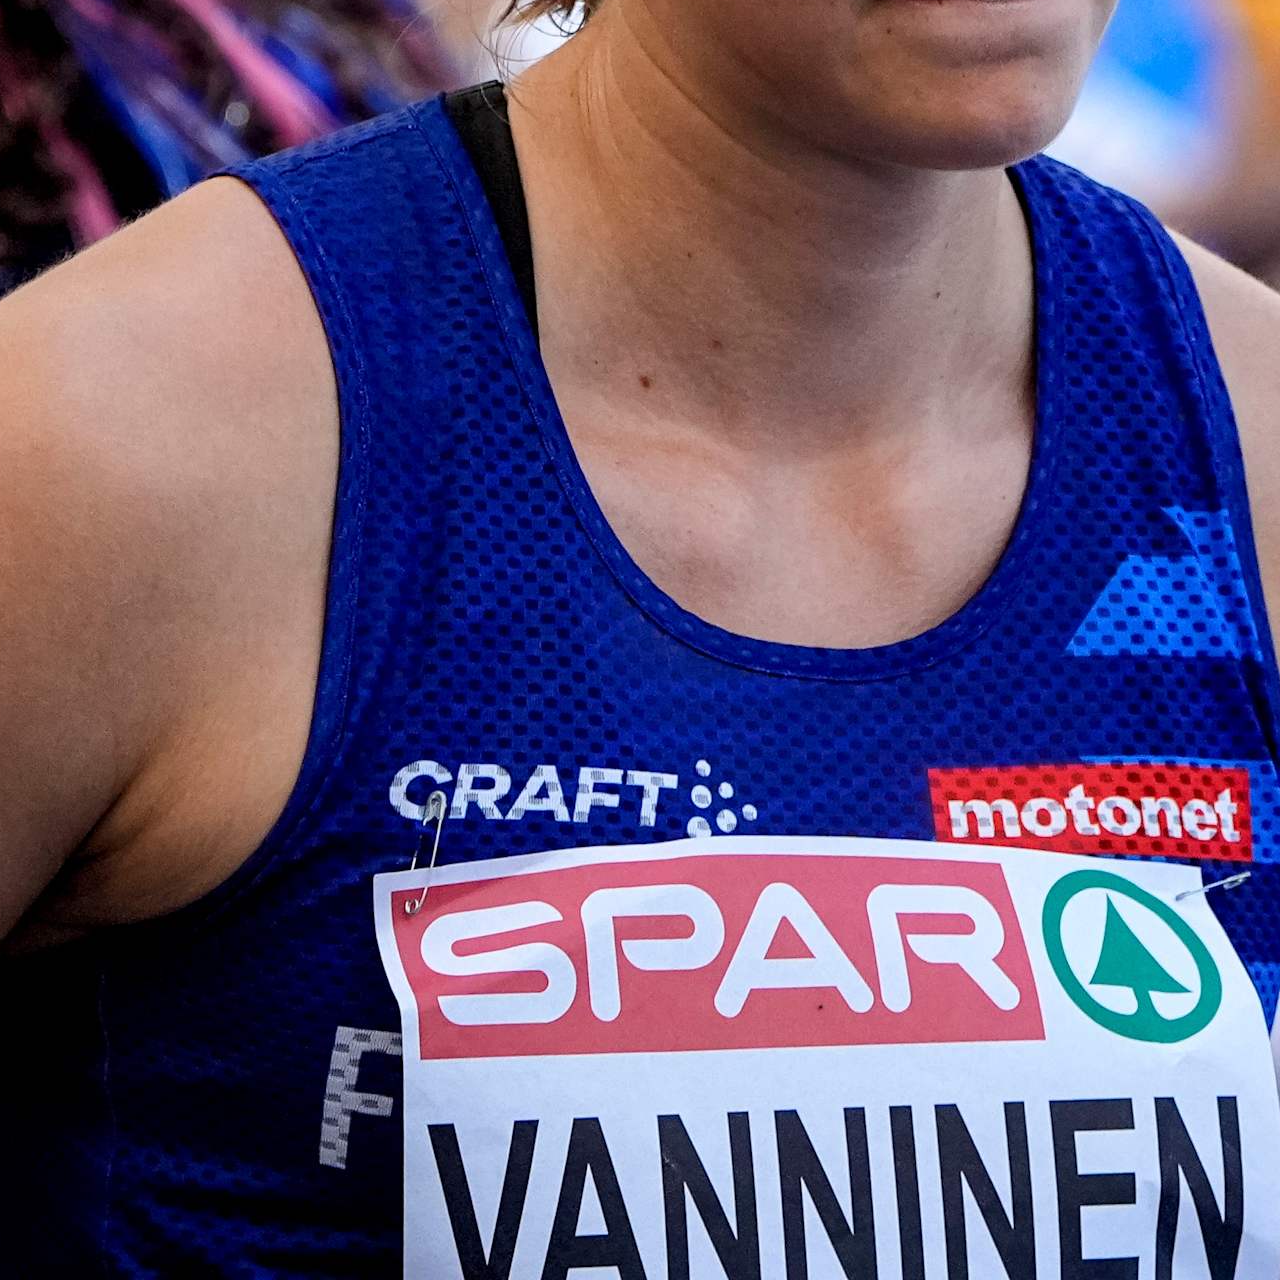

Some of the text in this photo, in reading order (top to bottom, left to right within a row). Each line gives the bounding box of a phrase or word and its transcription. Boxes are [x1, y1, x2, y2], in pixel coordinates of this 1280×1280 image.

[389, 759, 679, 827] CRAFT
[938, 783, 1241, 843] motonet
[420, 881, 1020, 1026] SPAR
[427, 1095, 1244, 1280] VANNINEN
